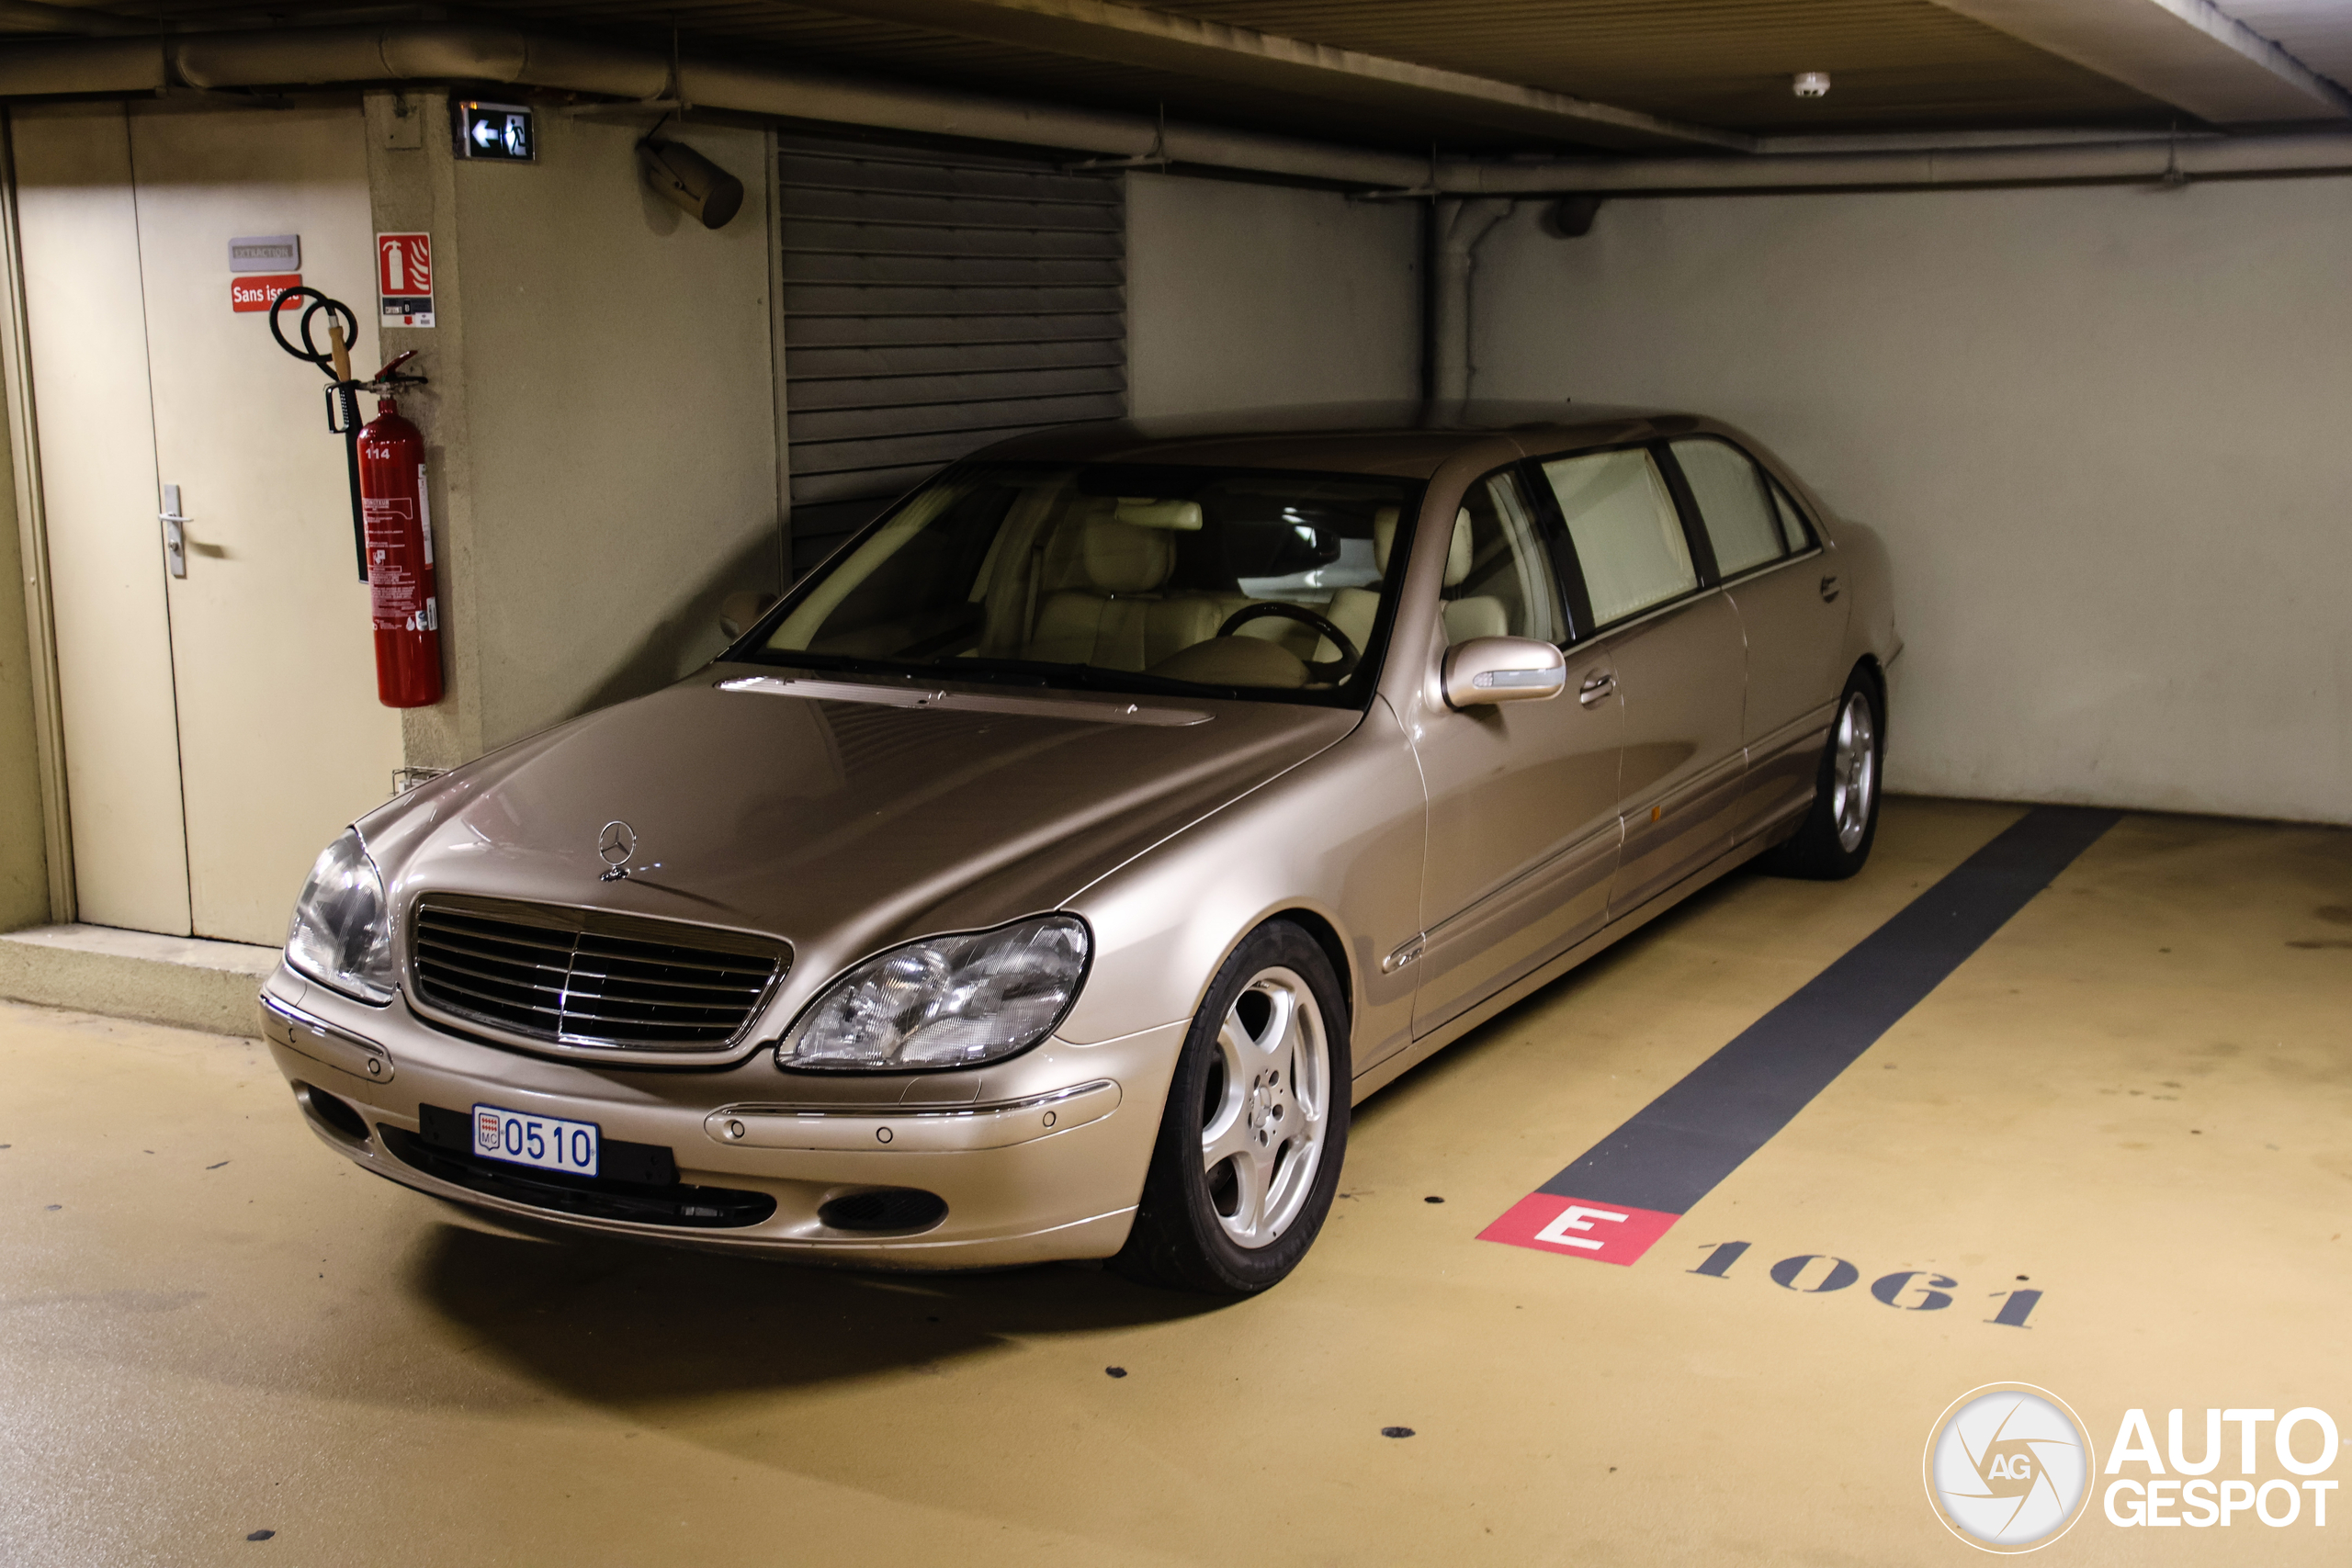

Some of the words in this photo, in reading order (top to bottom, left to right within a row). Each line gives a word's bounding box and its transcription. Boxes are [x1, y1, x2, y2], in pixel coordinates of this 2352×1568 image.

[234, 246, 288, 258] EXTRACTION
[233, 286, 265, 303] Sans
[366, 447, 390, 459] 114
[481, 1132, 498, 1145] MC
[504, 1118, 591, 1168] 0510
[1533, 1204, 1630, 1251] E
[1685, 1240, 2044, 1329] 1061
